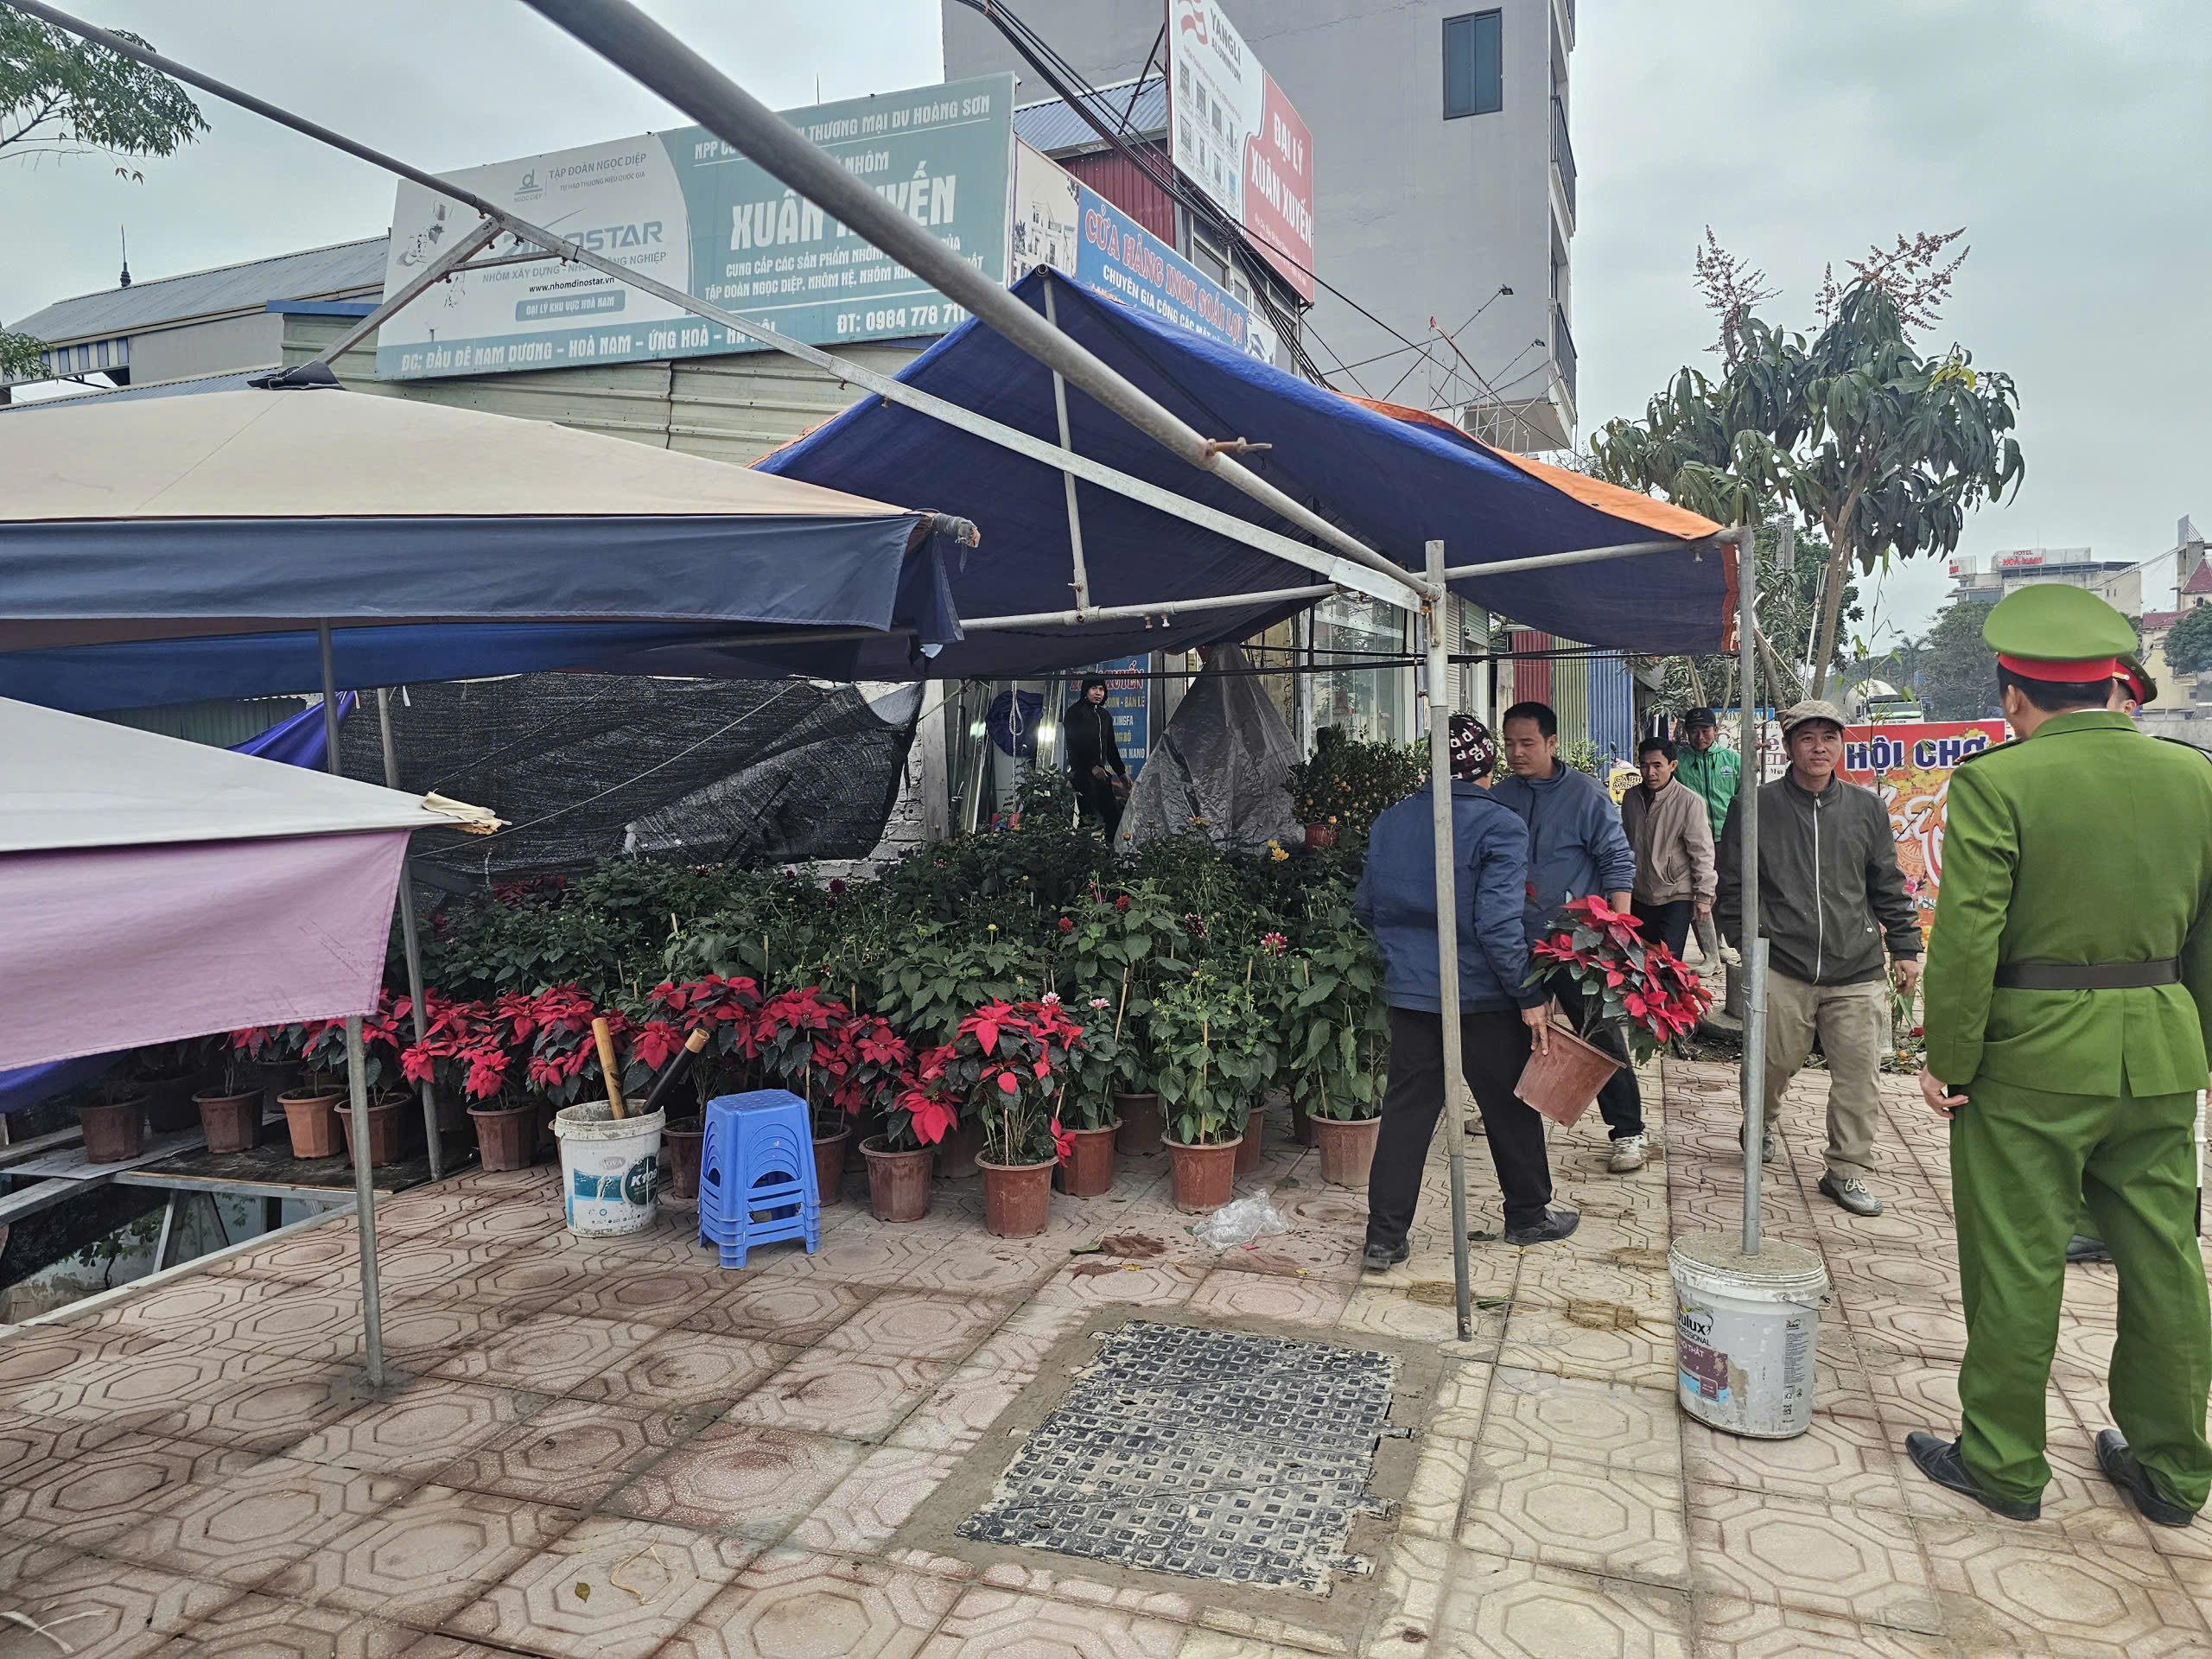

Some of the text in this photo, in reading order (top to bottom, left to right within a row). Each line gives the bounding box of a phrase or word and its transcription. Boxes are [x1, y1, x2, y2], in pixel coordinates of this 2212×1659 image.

[1210, 8, 1242, 67] YANGLI
[1211, 37, 1242, 84] ALUMINIUM
[809, 118, 858, 142] THƯƠNG
[861, 112, 888, 135] MẠI
[912, 101, 958, 125] HOÀNG
[962, 95, 990, 118] SƠN
[695, 141, 719, 160] NPP
[845, 150, 890, 175] NHÔM
[1274, 111, 1304, 177] ĐẠI LÝ
[549, 152, 647, 181] TẬP ĐOÀN NGỌC DIỆP
[1251, 145, 1312, 249] XUÂN XUYẾN
[729, 188, 824, 251] XUÂN
[482, 270, 510, 283] NHÔM
[512, 267, 530, 280] XÂY
[532, 264, 561, 278] DỰNG
[628, 251, 667, 266] NGHIỆP
[726, 260, 752, 277] CUNG
[753, 255, 773, 274] CẤP
[775, 254, 795, 272] CÁC
[797, 250, 817, 270] SẢN
[819, 245, 849, 267] PHẨM
[851, 245, 887, 264] NHÔM
[1085, 204, 1121, 261] CỬA
[1122, 233, 1164, 289] HÀNG
[1166, 264, 1198, 311] INOX
[529, 276, 615, 293] www.nhomdinostar.vn
[704, 284, 722, 303] TẬP
[724, 282, 751, 300] ĐOÀN
[752, 279, 779, 297] NGỌC
[808, 271, 840, 289] NHÔM
[859, 266, 892, 284] NHÔM
[1103, 264, 1139, 300] CHUYÊN
[1141, 289, 1155, 310] GIA
[1157, 298, 1179, 324] CÔNG
[525, 303, 539, 317] ĐẠI
[539, 302, 548, 314] LÝ
[549, 301, 564, 312] KHU
[597, 296, 615, 308] NAM
[836, 314, 861, 334] ĐT:
[866, 308, 906, 331] 0984
[910, 305, 938, 327] 778
[401, 354, 423, 372] ĐC:
[425, 345, 452, 369] ĐẦU
[474, 346, 505, 366] NAM
[508, 341, 553, 363] DƯƠNG
[598, 334, 632, 355] NAM
[648, 327, 677, 352] ỨNG
[1844, 735, 1905, 776] HỘI
